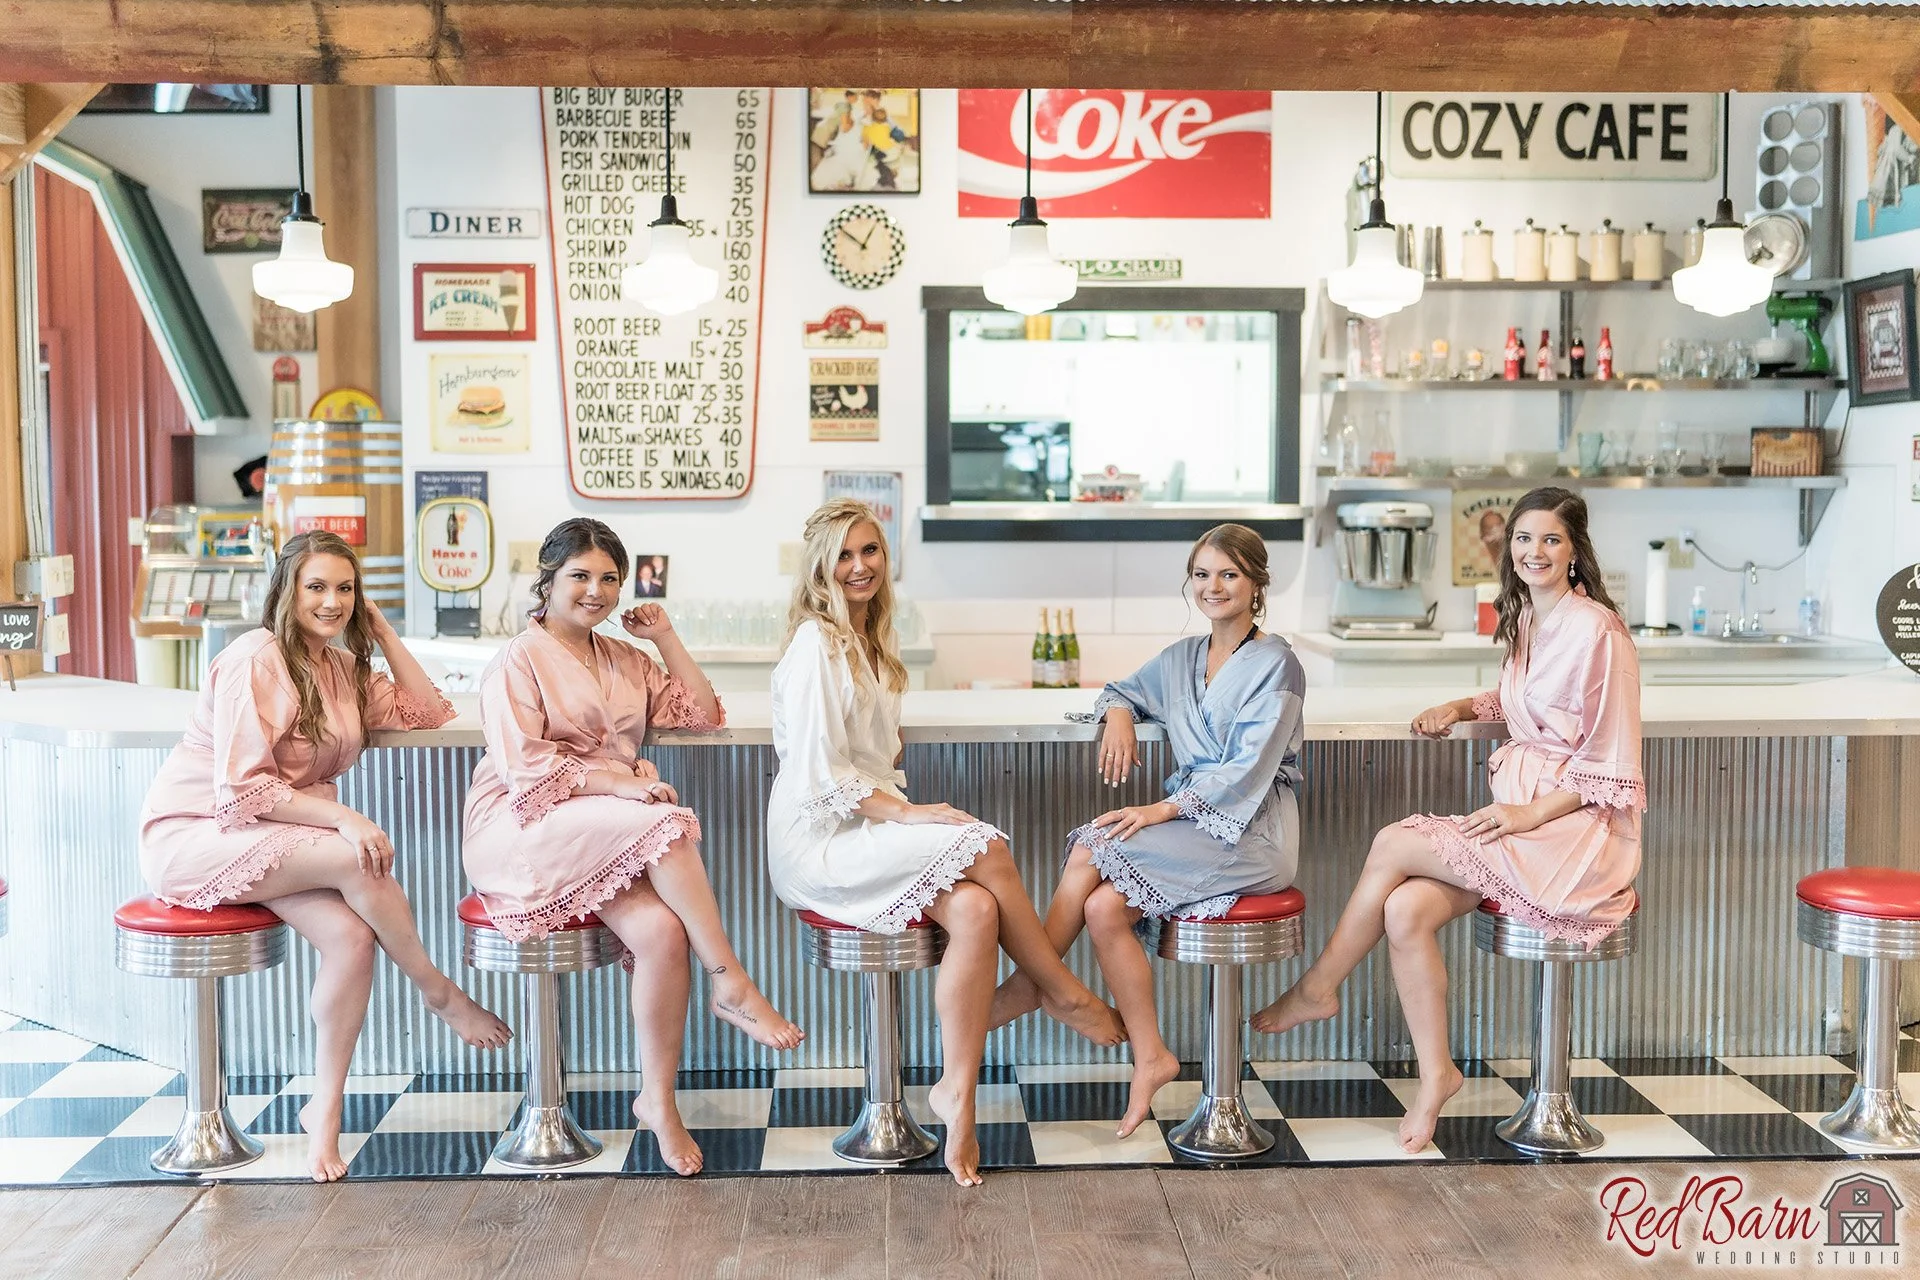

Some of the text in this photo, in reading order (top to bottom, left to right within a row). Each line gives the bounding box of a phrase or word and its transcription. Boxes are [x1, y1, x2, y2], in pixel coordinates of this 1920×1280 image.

[554, 87, 760, 108] BIG BUY BURGER 65
[556, 109, 756, 129] BARBECUE BEEF 65
[1010, 89, 1212, 161] Coke
[1402, 101, 1688, 160] COZY CAFE
[560, 131, 755, 150] PORK TENDERLOIN 70
[561, 152, 755, 172] FISH SANDWICH 50
[562, 174, 754, 194] GRILLED CHEESE 35
[564, 196, 753, 217] HOT DOG 25
[430, 212, 523, 233] DINER
[566, 218, 633, 236] CHICKEN
[567, 240, 627, 258] SHRIMP
[728, 264, 750, 282] 30
[430, 289, 498, 316] ICE CREAM
[569, 283, 749, 303] ONION 40
[574, 318, 747, 337] ROOT BEER 15 25
[576, 340, 743, 358] ORANGE 15 25
[574, 361, 743, 380] CHOCOLATE MALT 30
[575, 383, 744, 402] ROOT BEER FLOAT 25 35
[576, 404, 742, 425] ORANGE FLOAT 25 35
[578, 427, 742, 447] MALTS AND SHAKES 40
[580, 449, 738, 468] COFFEE 15 MILK 15
[584, 471, 744, 490] CONES 15 SUNDAES 40
[330, 519, 358, 531] BEER
[432, 549, 465, 558] Have
